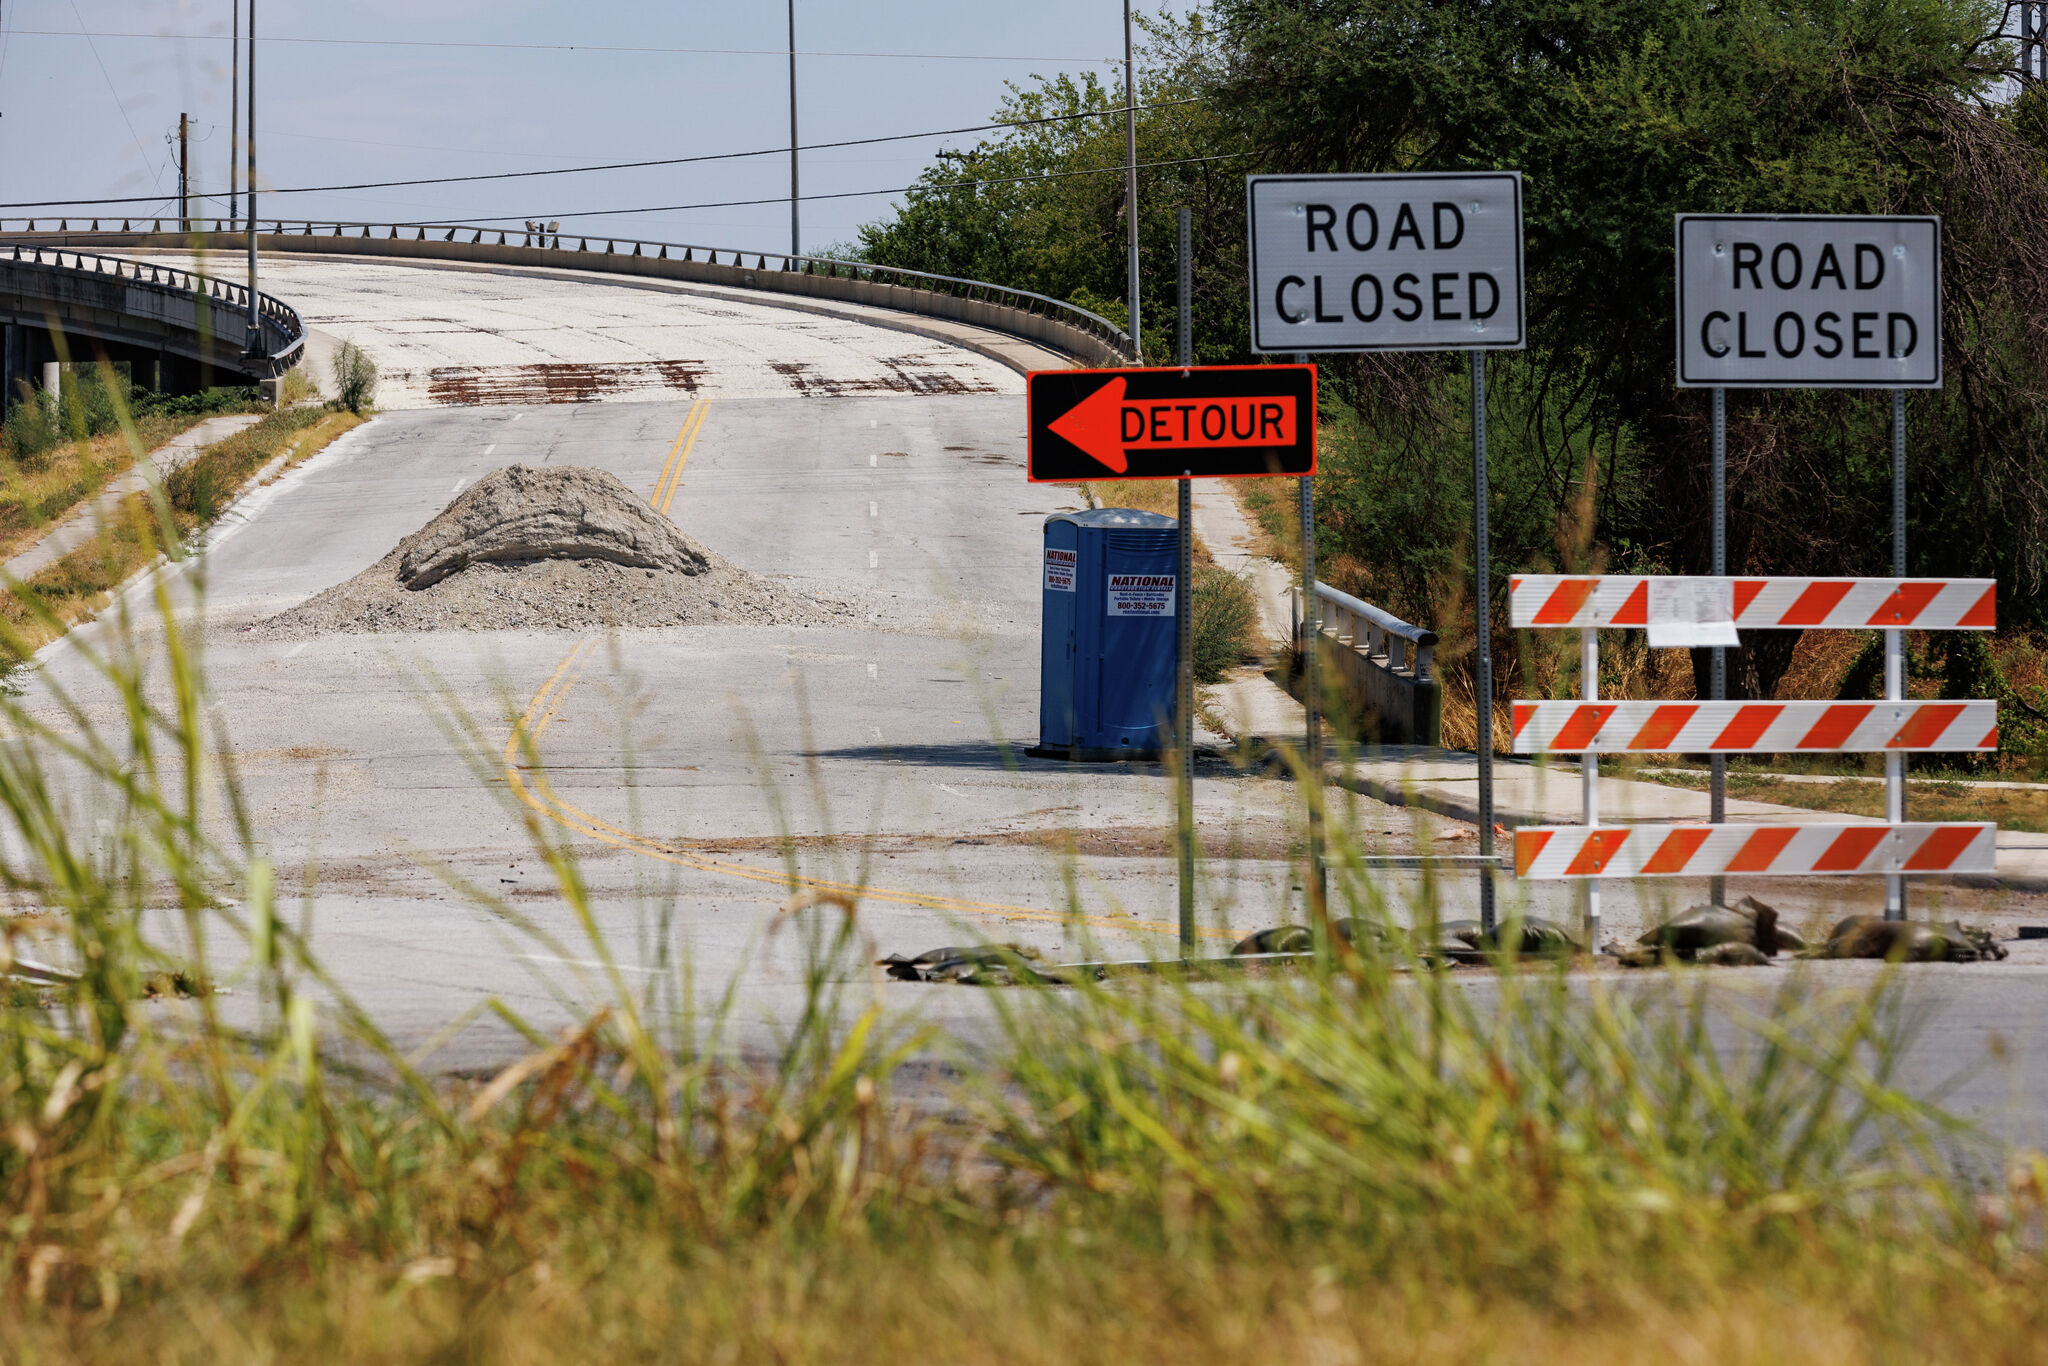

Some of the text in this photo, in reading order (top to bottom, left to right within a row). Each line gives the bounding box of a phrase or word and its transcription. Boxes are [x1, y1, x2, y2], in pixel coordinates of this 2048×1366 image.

[1305, 201, 1466, 253] ROAD
[1732, 241, 1887, 291] ROAD
[1274, 271, 1502, 325] CLOSED
[1700, 310, 1919, 360] CLOSED
[1120, 403, 1285, 443] DETOUR
[1046, 550, 1076, 562] NATIONAL
[1111, 575, 1174, 586] NATIONAL
[1117, 602, 1166, 610] 800-352-5675
